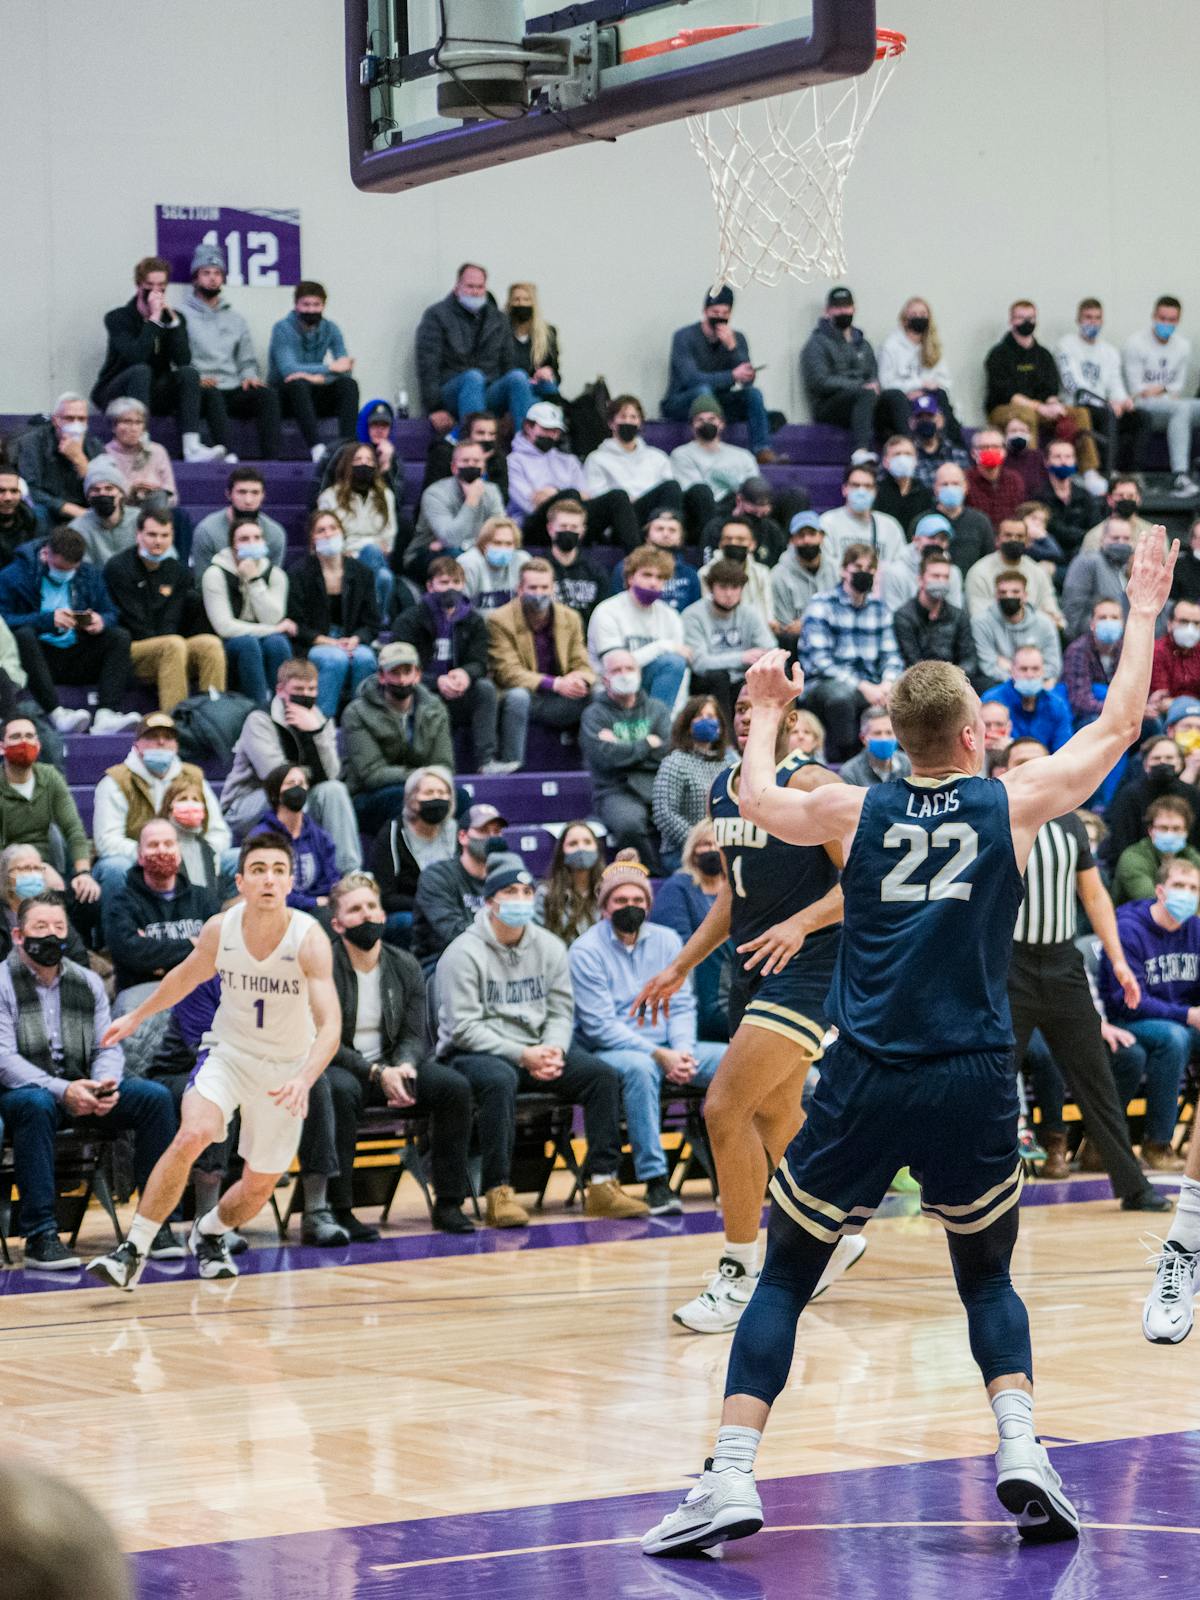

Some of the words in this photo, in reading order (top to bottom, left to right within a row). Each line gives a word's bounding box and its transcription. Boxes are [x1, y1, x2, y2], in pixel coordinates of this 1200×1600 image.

[202, 230, 279, 287] 12
[906, 788, 960, 819] LACIS
[731, 855, 747, 898] 1
[880, 822, 979, 902] 22
[240, 974, 300, 996] THOMAS
[505, 975, 546, 1004] CENTRA
[253, 998, 265, 1029] 1
